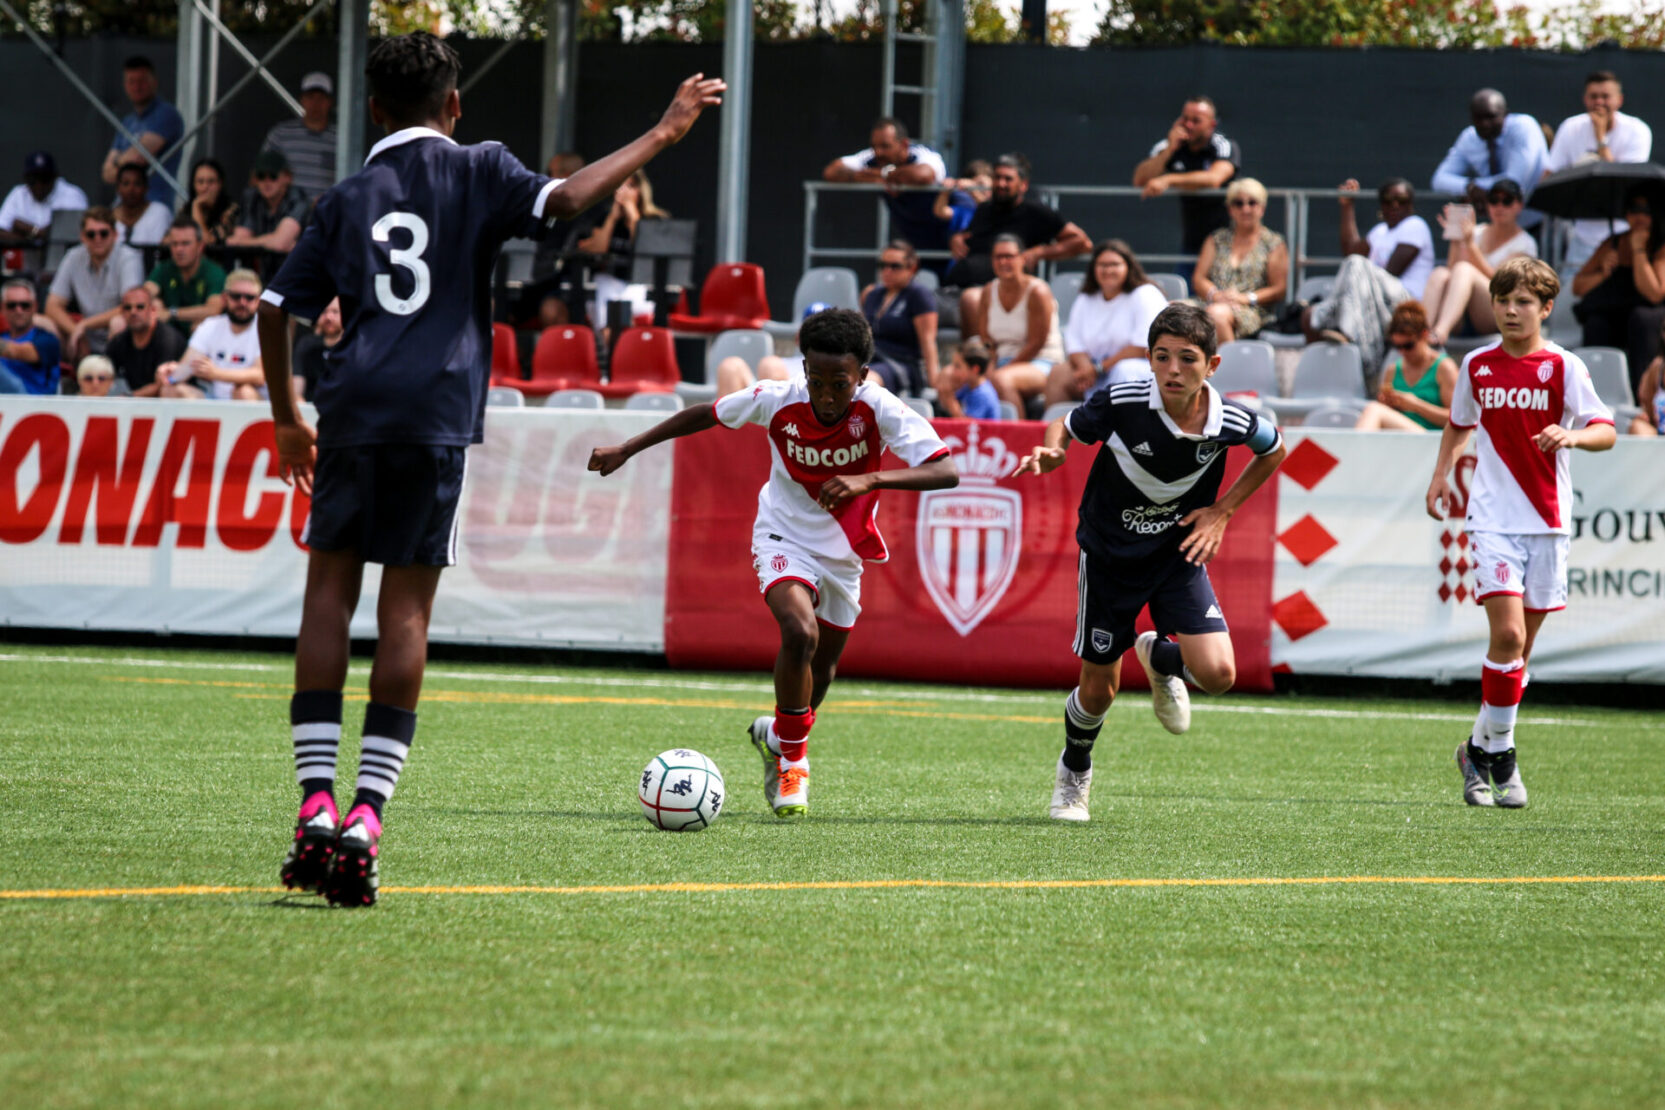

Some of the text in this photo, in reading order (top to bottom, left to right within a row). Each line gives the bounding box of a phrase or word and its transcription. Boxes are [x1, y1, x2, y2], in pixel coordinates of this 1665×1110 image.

[371, 211, 431, 315] 3
[1478, 387, 1549, 411] FEDCOM
[786, 438, 869, 467] FEDCOM
[0, 411, 312, 552] ONAC
[1567, 566, 1665, 598] RINCI
